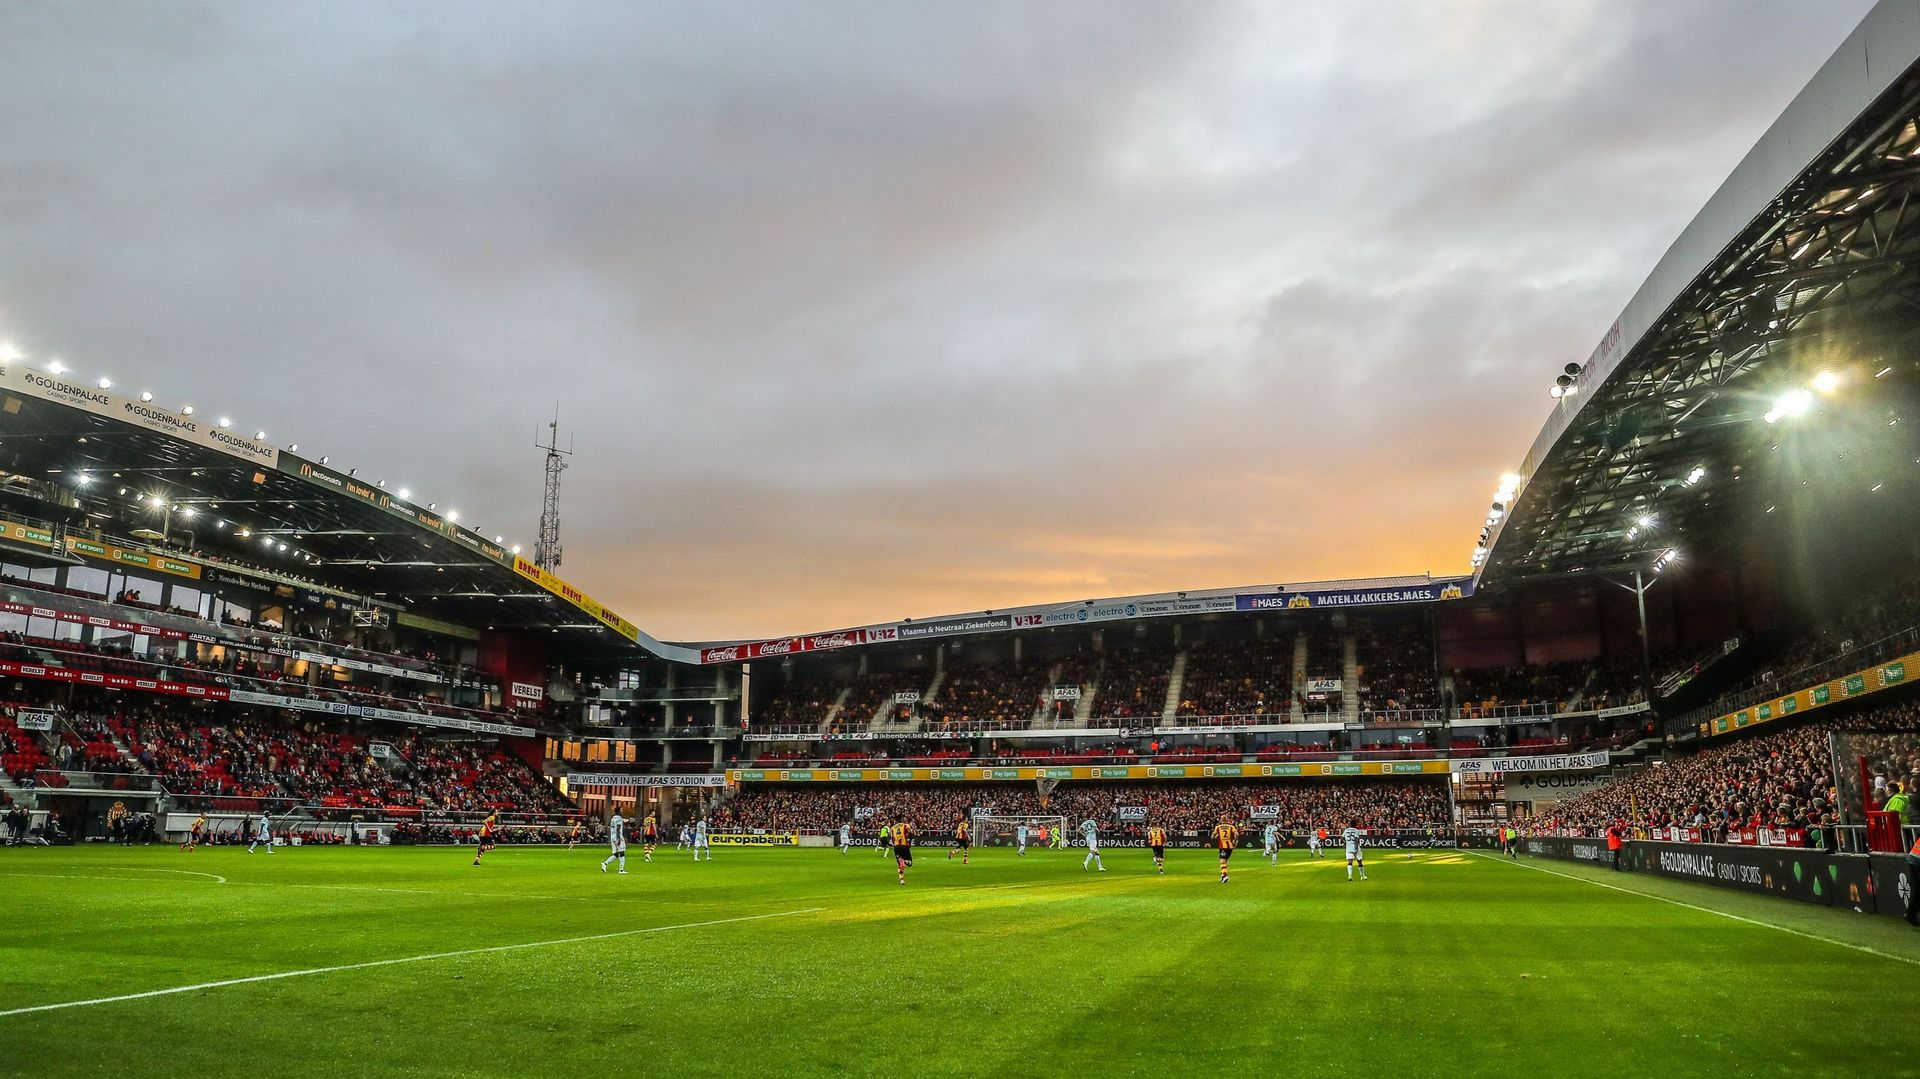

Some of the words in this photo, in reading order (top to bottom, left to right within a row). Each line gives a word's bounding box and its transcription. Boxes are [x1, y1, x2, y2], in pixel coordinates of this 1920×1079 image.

[36, 376, 108, 406] GOLDENPALACE
[47, 390, 66, 400] CASINO
[69, 397, 86, 406] SPORTS
[134, 406, 196, 432] GOLDENPALACE
[217, 433, 272, 458] GOLDENPALACE
[312, 471, 341, 486] McDonald's
[390, 502, 415, 517] McDonald's
[456, 532, 478, 546] McDonald's
[88, 545, 104, 553] SPORTS
[518, 560, 540, 579] BREMS
[562, 585, 581, 603] BREMS
[1258, 598, 1282, 608] MAES
[1318, 590, 1434, 605] MATEN.KAKKERS.MAES.
[602, 609, 620, 626] BREMS
[1046, 612, 1075, 621] electro
[1094, 608, 1123, 616] electro
[902, 626, 926, 636] Vlaams
[935, 622, 964, 632] Neutraal
[965, 619, 1007, 630] Ziekenfonds
[514, 684, 541, 698] VERELST
[24, 714, 48, 722] AFAS
[1492, 760, 1536, 770] WELKOM
[1538, 759, 1548, 769] IN
[1550, 758, 1567, 768] HET
[1569, 756, 1585, 767] AFAS
[582, 776, 617, 784] WELKOM
[621, 776, 629, 784] IN
[632, 776, 646, 784] HET
[671, 776, 705, 785] STADION
[712, 835, 793, 846] europabank
[1666, 852, 1714, 877] GOLDENPALACE
[1718, 863, 1736, 880] CASINO
[1740, 866, 1761, 884] SPORTS
